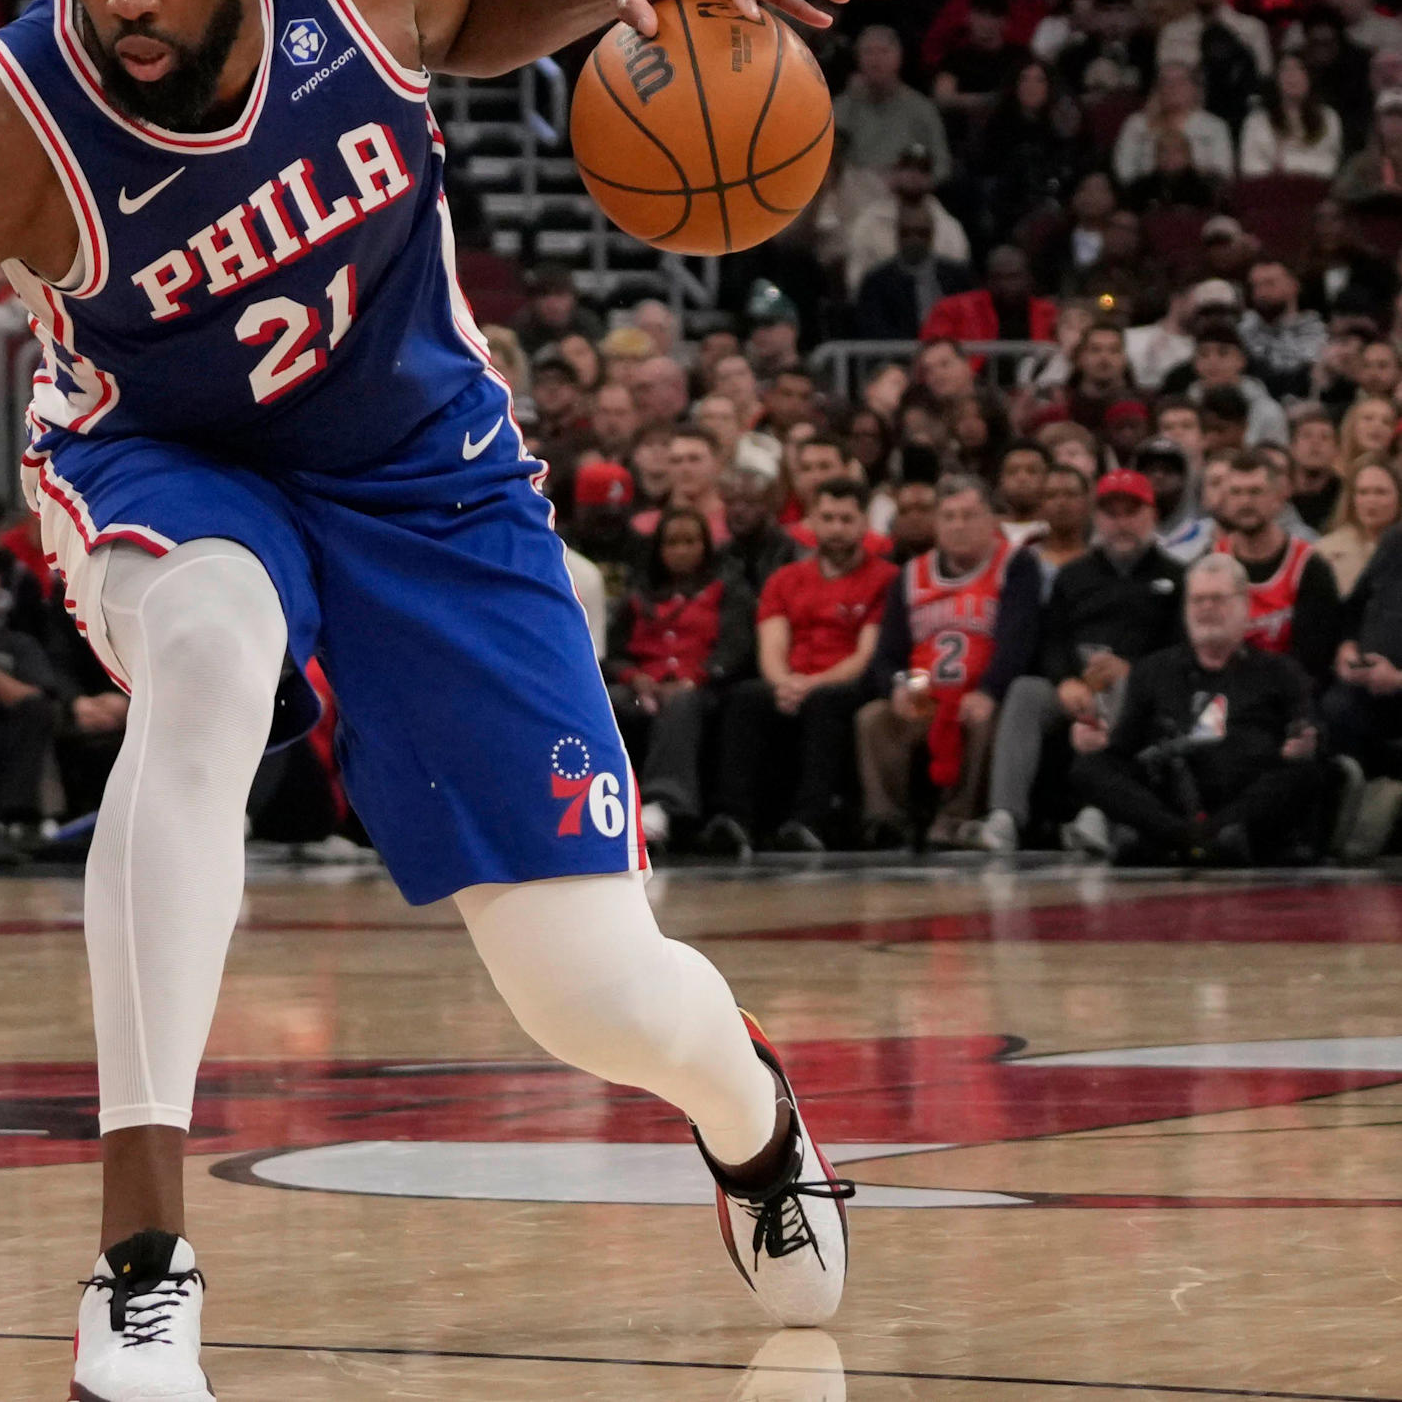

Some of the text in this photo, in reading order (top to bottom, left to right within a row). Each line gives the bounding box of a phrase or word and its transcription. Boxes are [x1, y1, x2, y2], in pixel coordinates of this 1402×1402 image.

[290, 46, 358, 102] crypto.com
[130, 122, 416, 323] PHILA
[234, 263, 358, 405] 21
[933, 629, 971, 686] 2
[549, 771, 626, 839] 76
